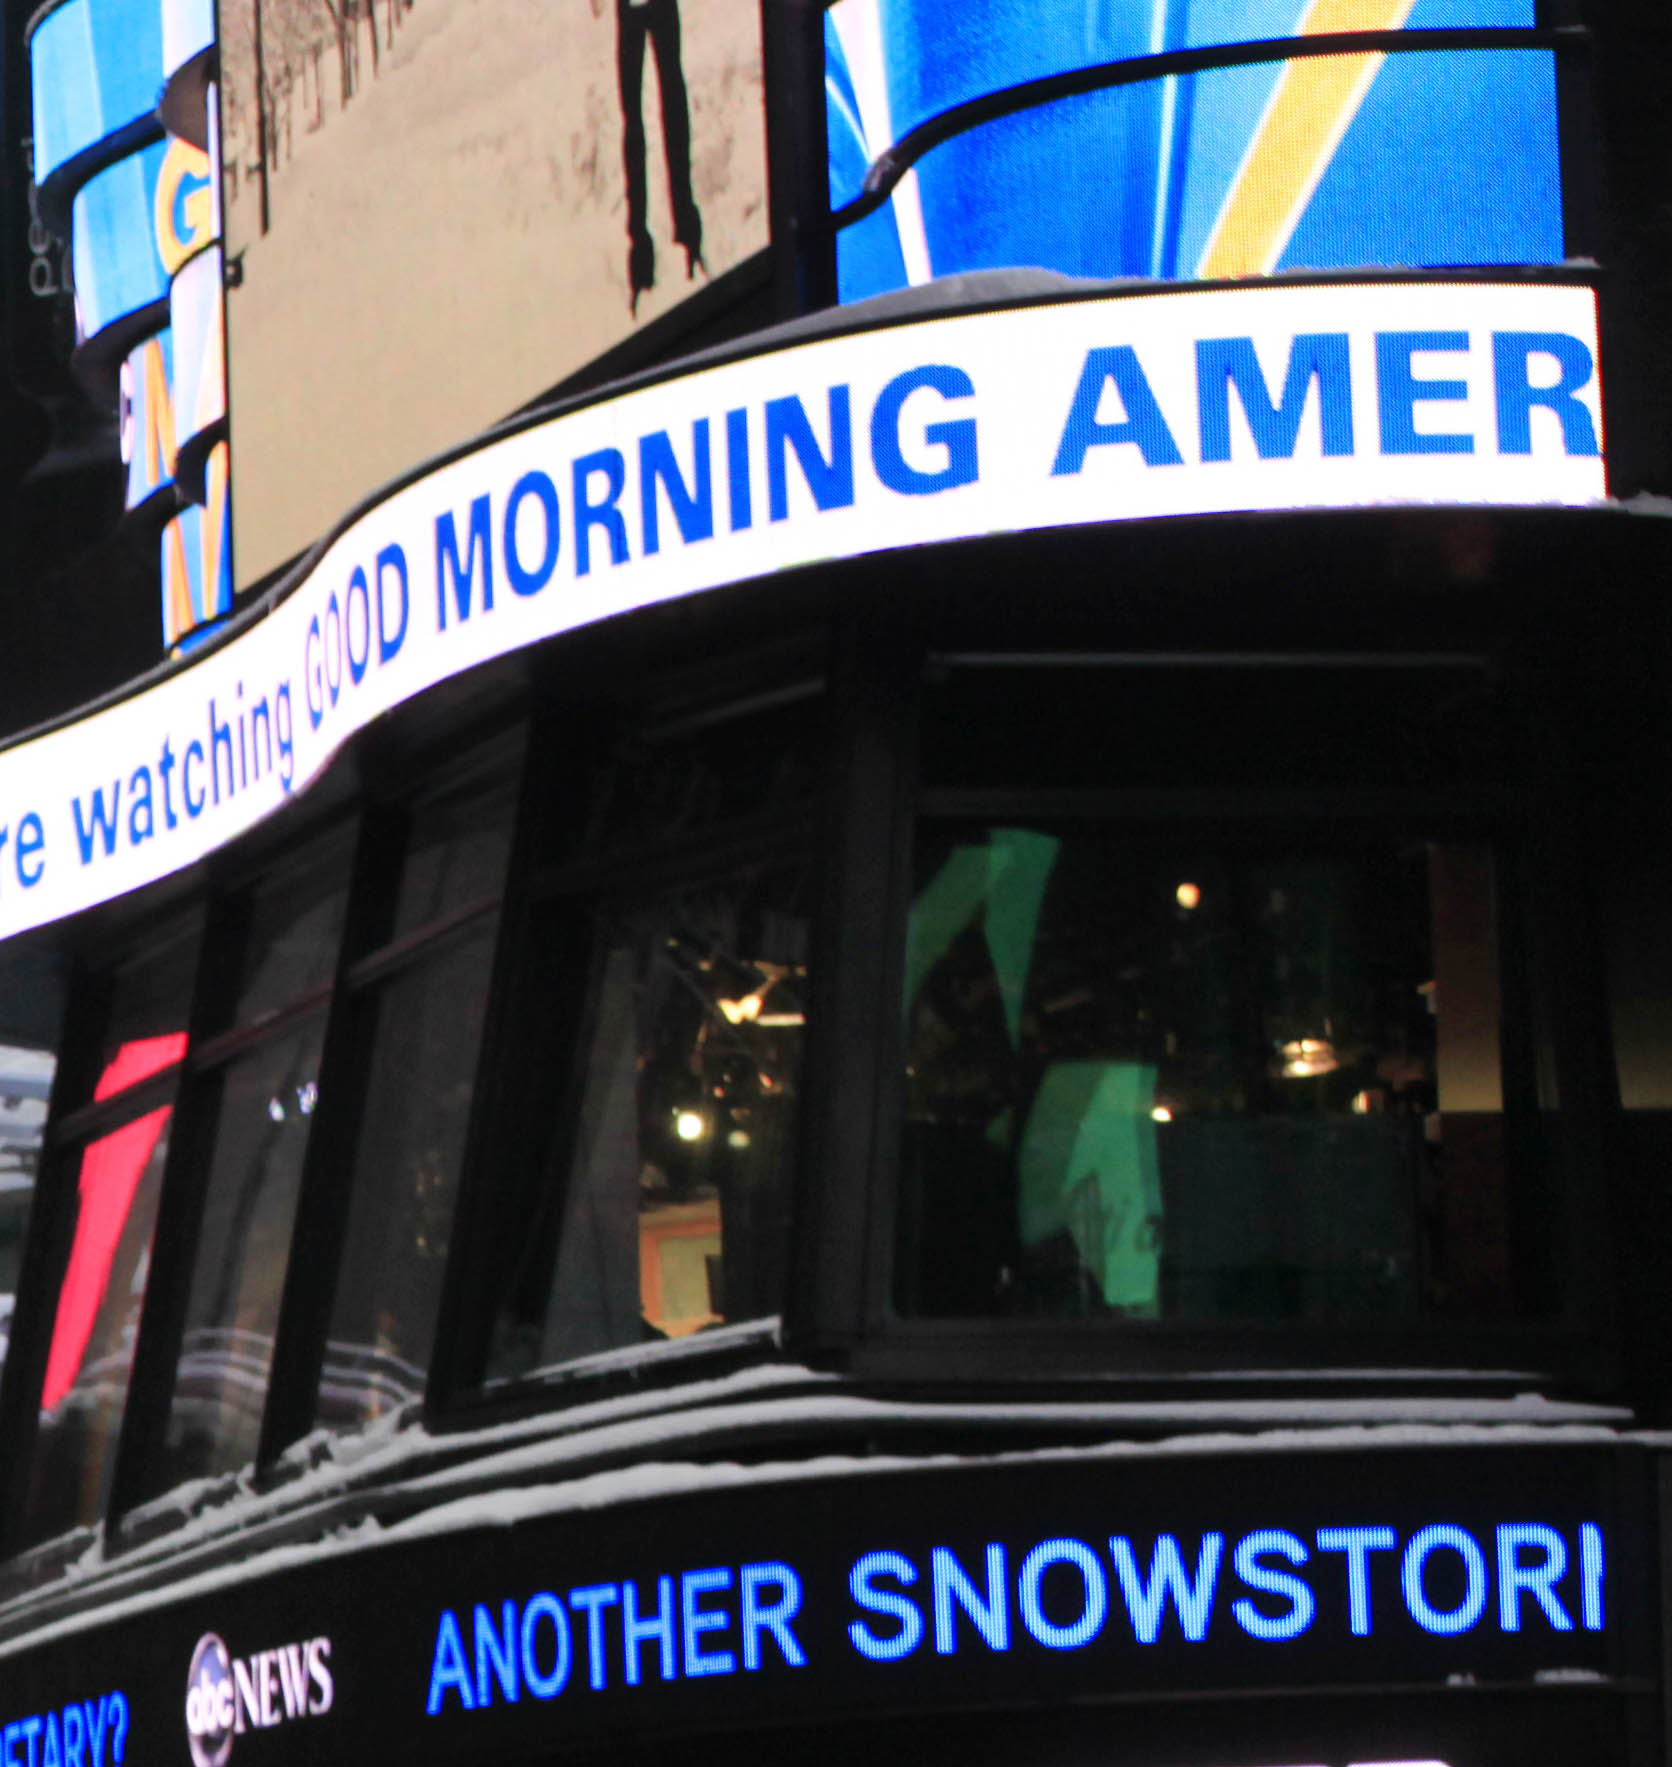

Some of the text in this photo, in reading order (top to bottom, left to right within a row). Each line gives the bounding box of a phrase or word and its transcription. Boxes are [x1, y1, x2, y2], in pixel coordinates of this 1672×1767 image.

[71, 679, 295, 866] watching
[305, 541, 410, 732] GOOD
[435, 363, 979, 635] MORNING
[1050, 328, 1599, 478] AMER
[186, 1636, 334, 1735] abc NEWS
[425, 1557, 808, 1717] ANOTHER
